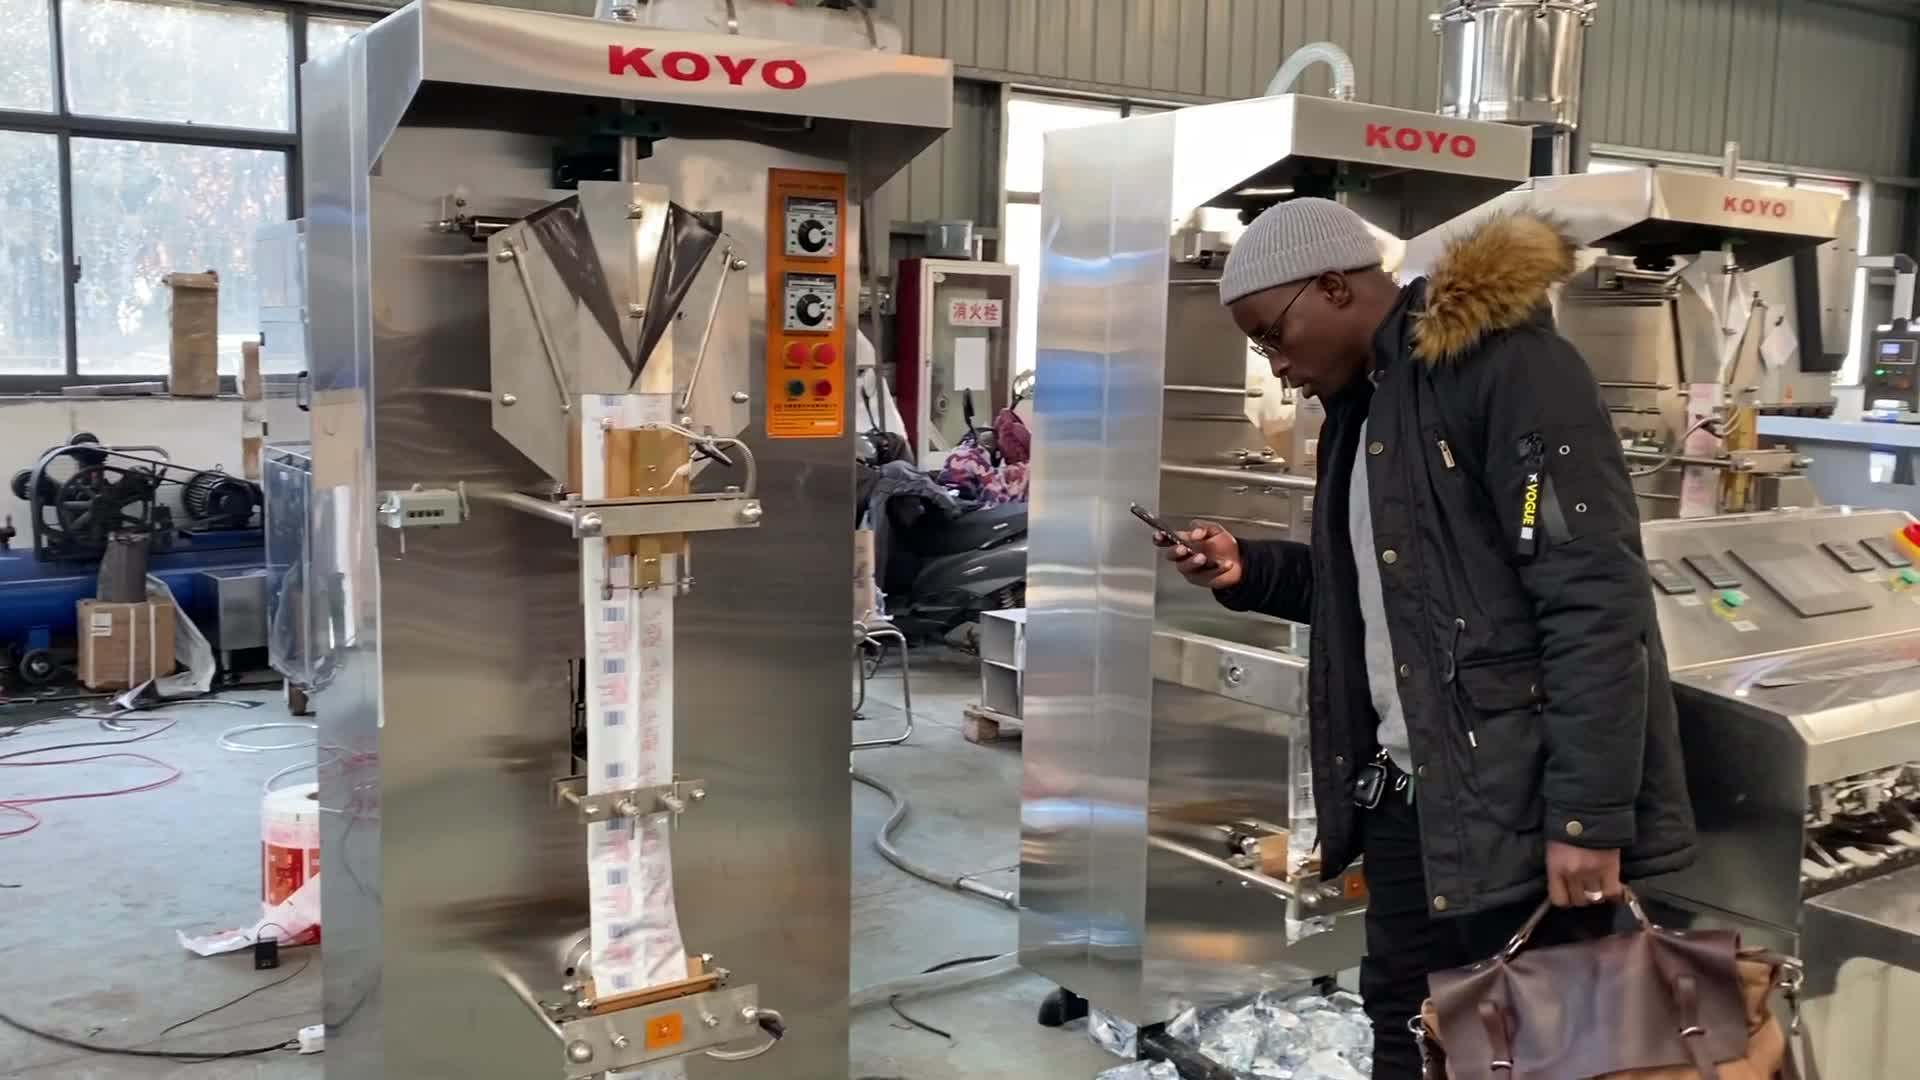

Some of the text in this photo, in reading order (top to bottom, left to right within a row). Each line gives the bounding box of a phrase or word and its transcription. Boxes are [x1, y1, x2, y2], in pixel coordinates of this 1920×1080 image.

[608, 45, 807, 89] KOYO
[1366, 124, 1476, 158] KOYO
[1724, 197, 1786, 218] KOYO
[953, 303, 999, 320] 消火栓
